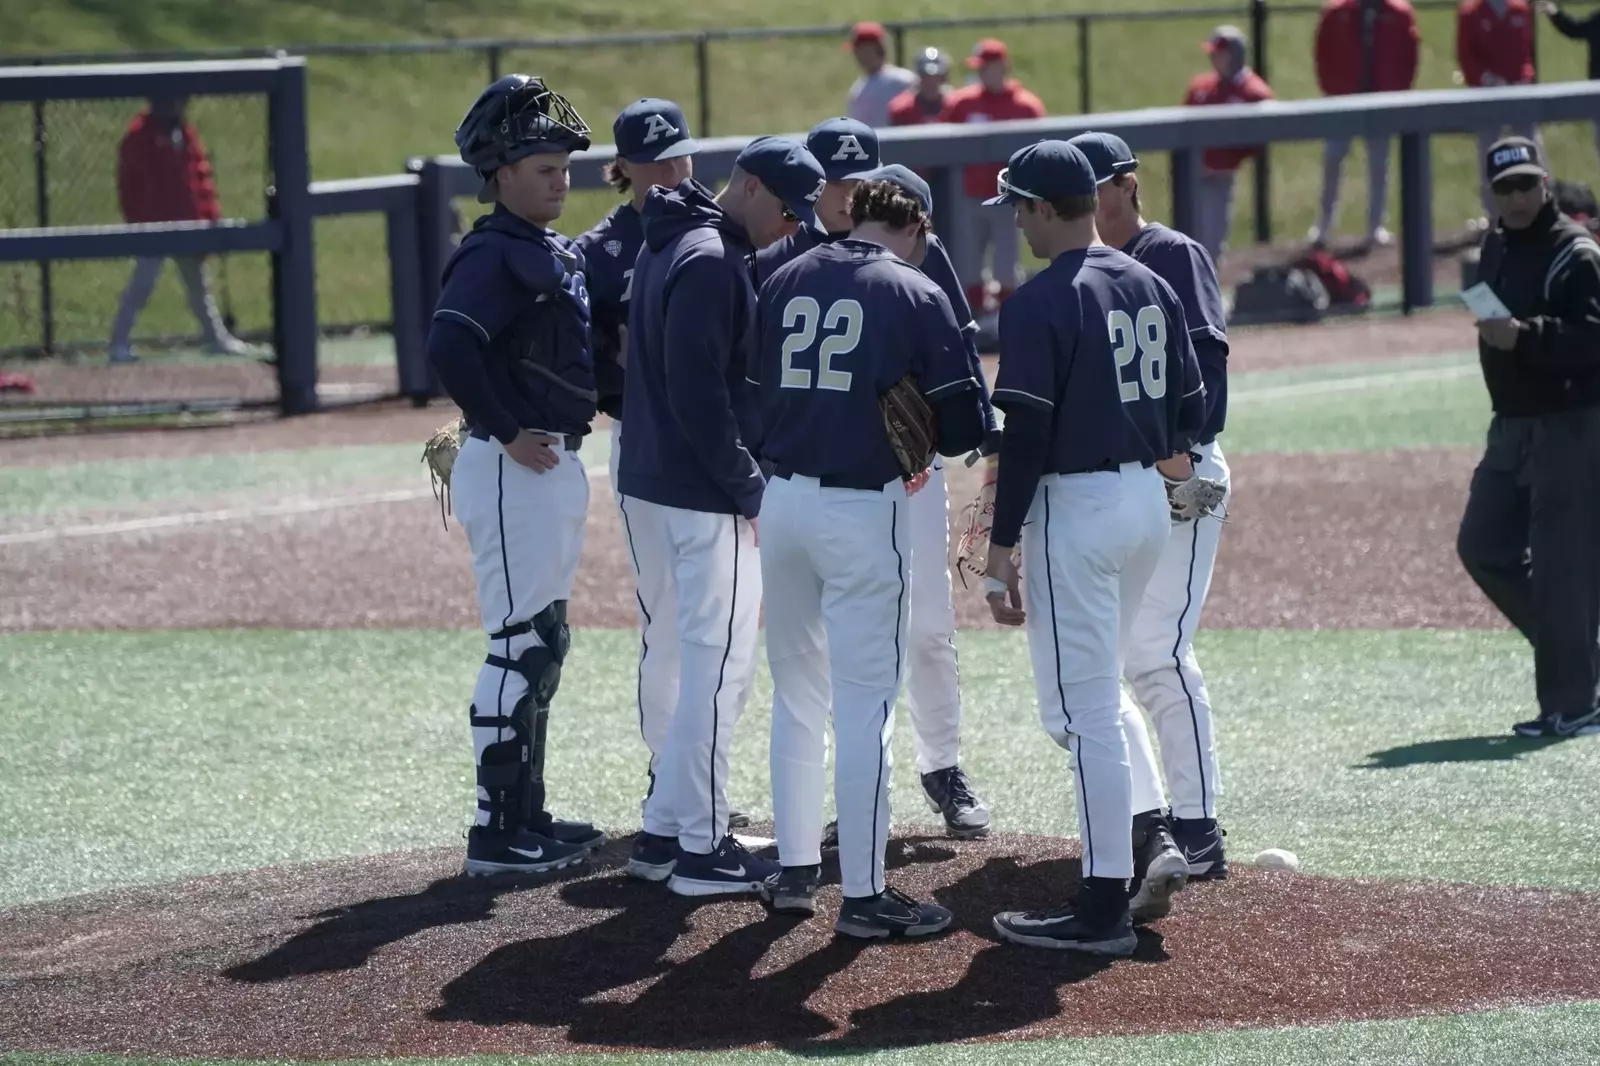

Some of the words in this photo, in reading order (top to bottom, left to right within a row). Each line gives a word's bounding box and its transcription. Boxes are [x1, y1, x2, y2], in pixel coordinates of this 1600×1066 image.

[643, 113, 680, 145] A
[831, 135, 870, 161] A
[780, 296, 863, 391] 22
[1108, 305, 1168, 403] 28
